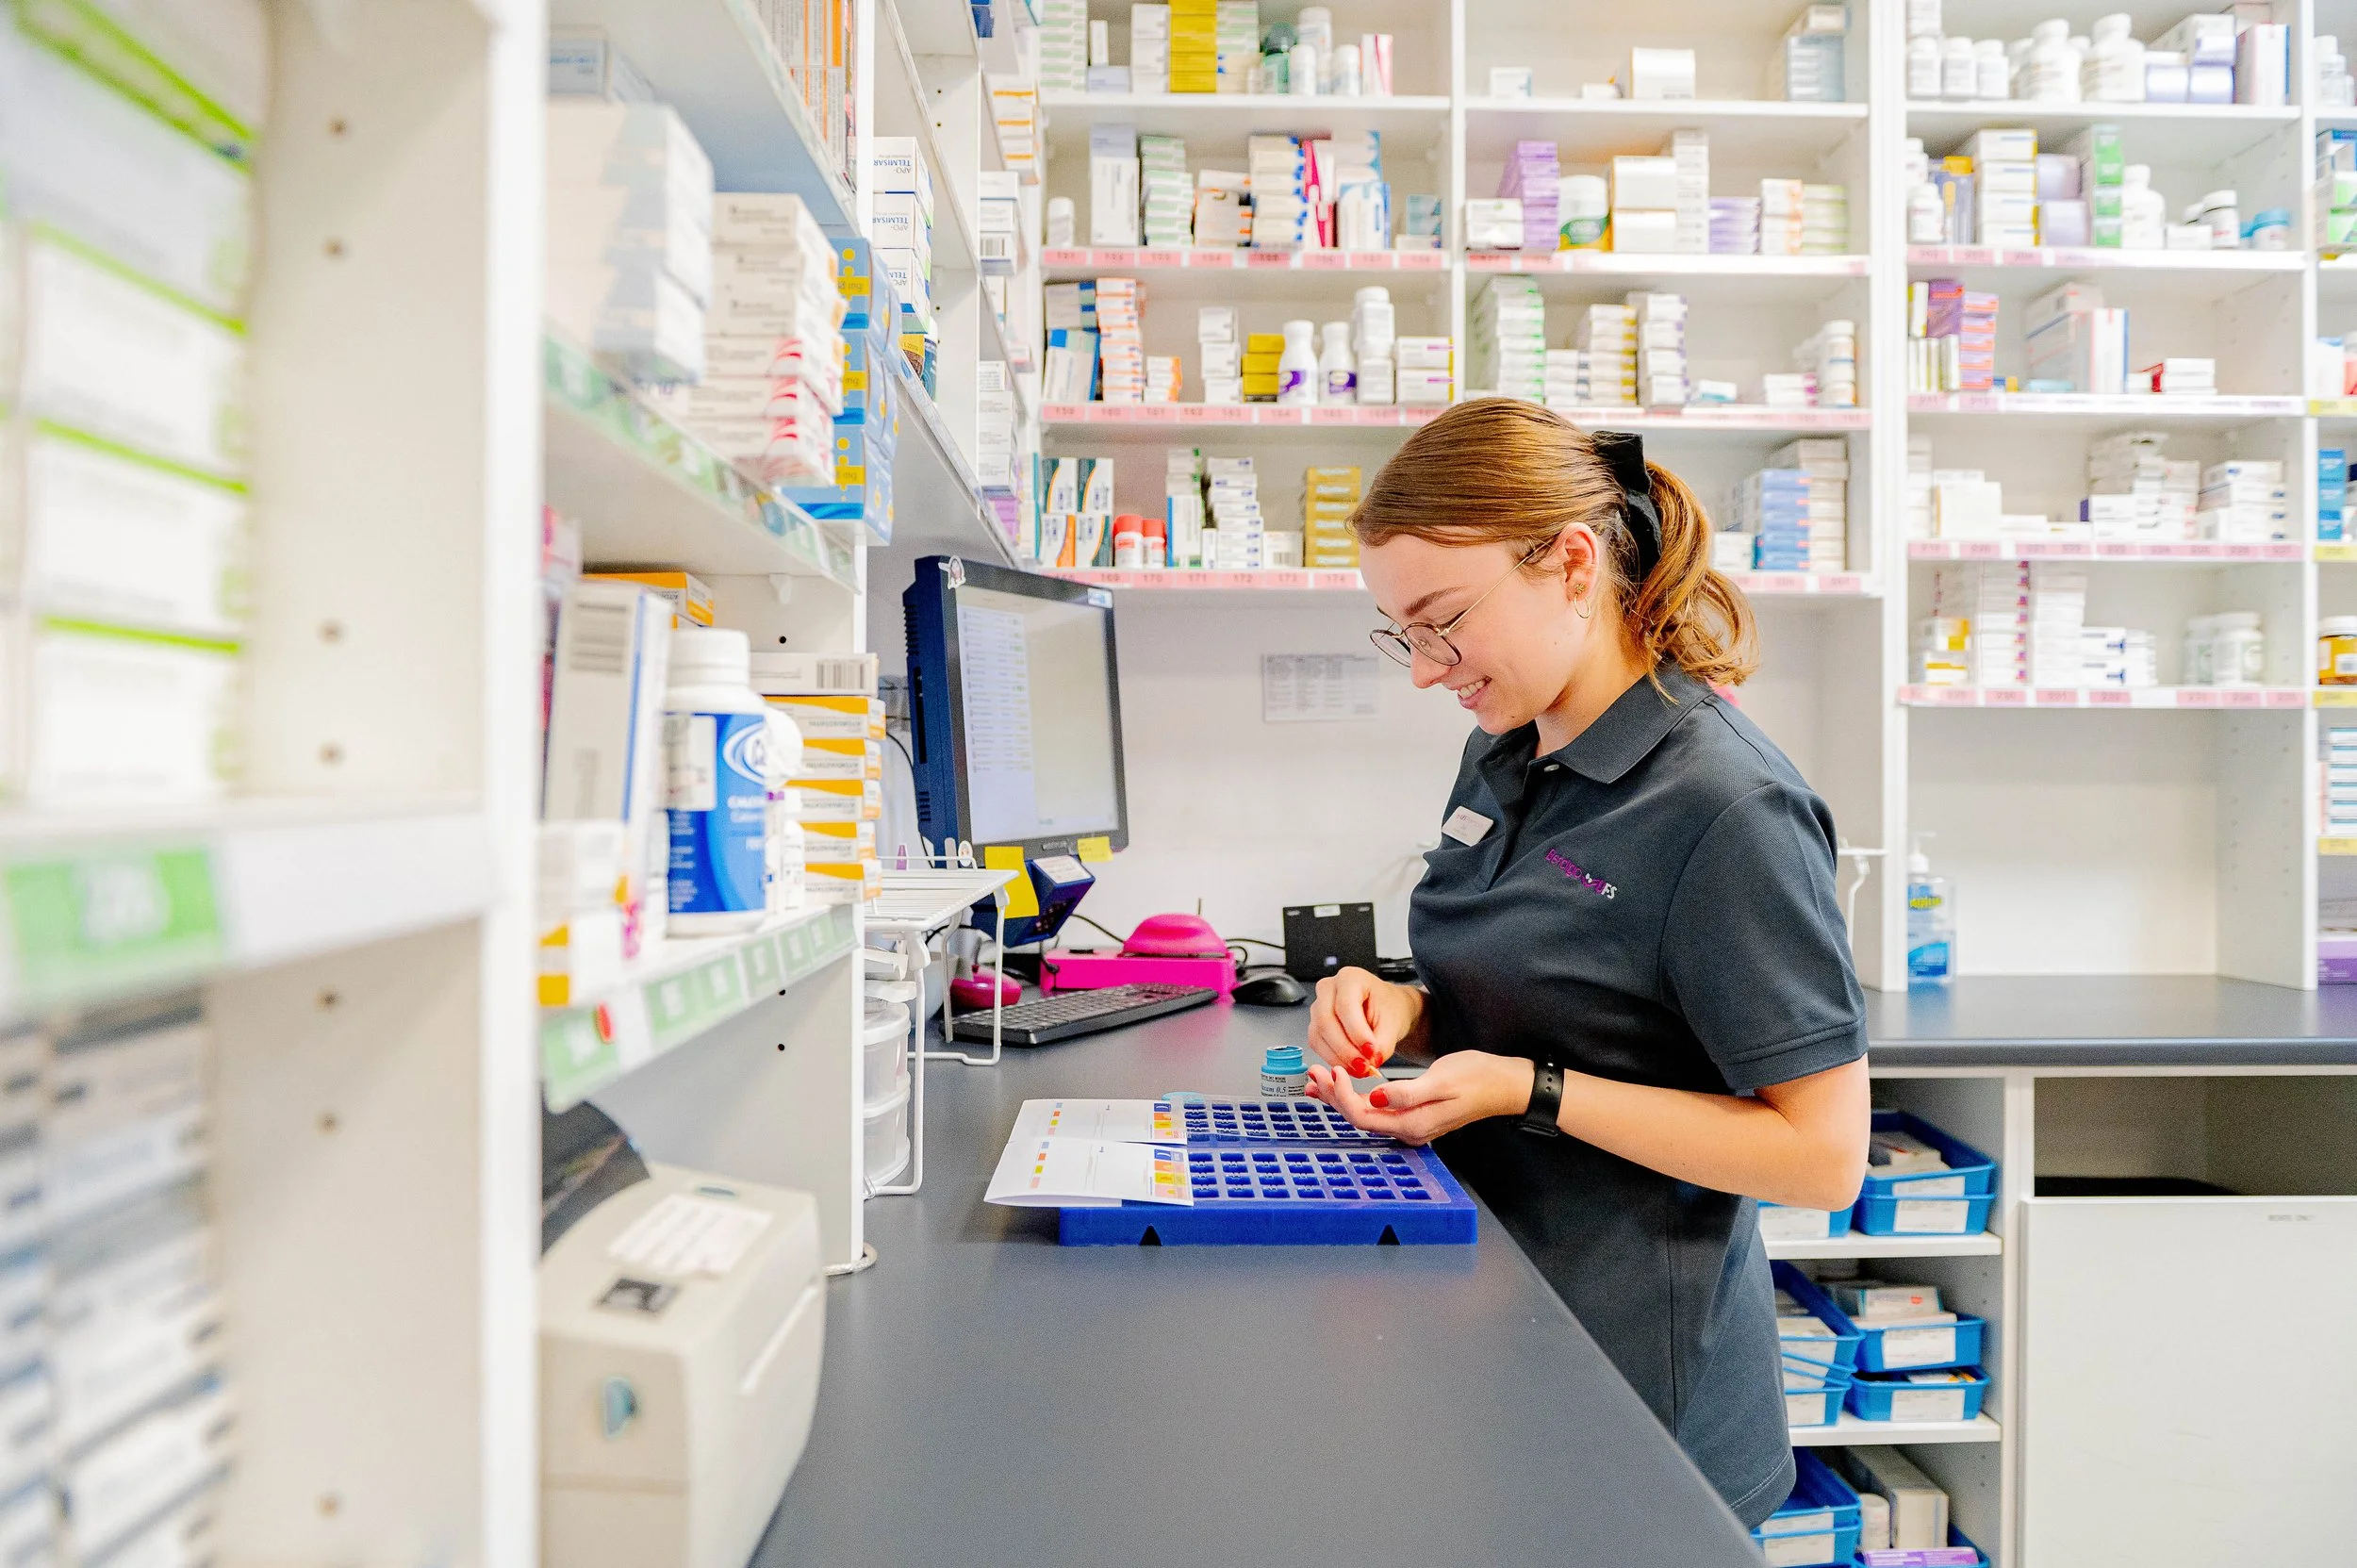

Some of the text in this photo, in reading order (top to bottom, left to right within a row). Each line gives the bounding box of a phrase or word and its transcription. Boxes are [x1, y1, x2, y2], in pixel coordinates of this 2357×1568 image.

[1143, 573, 1163, 583] 170
[1188, 573, 1206, 583] 171
[1233, 573, 1253, 583] 172
[1278, 574, 1297, 583] 173
[1594, 879, 1617, 900] UFS
